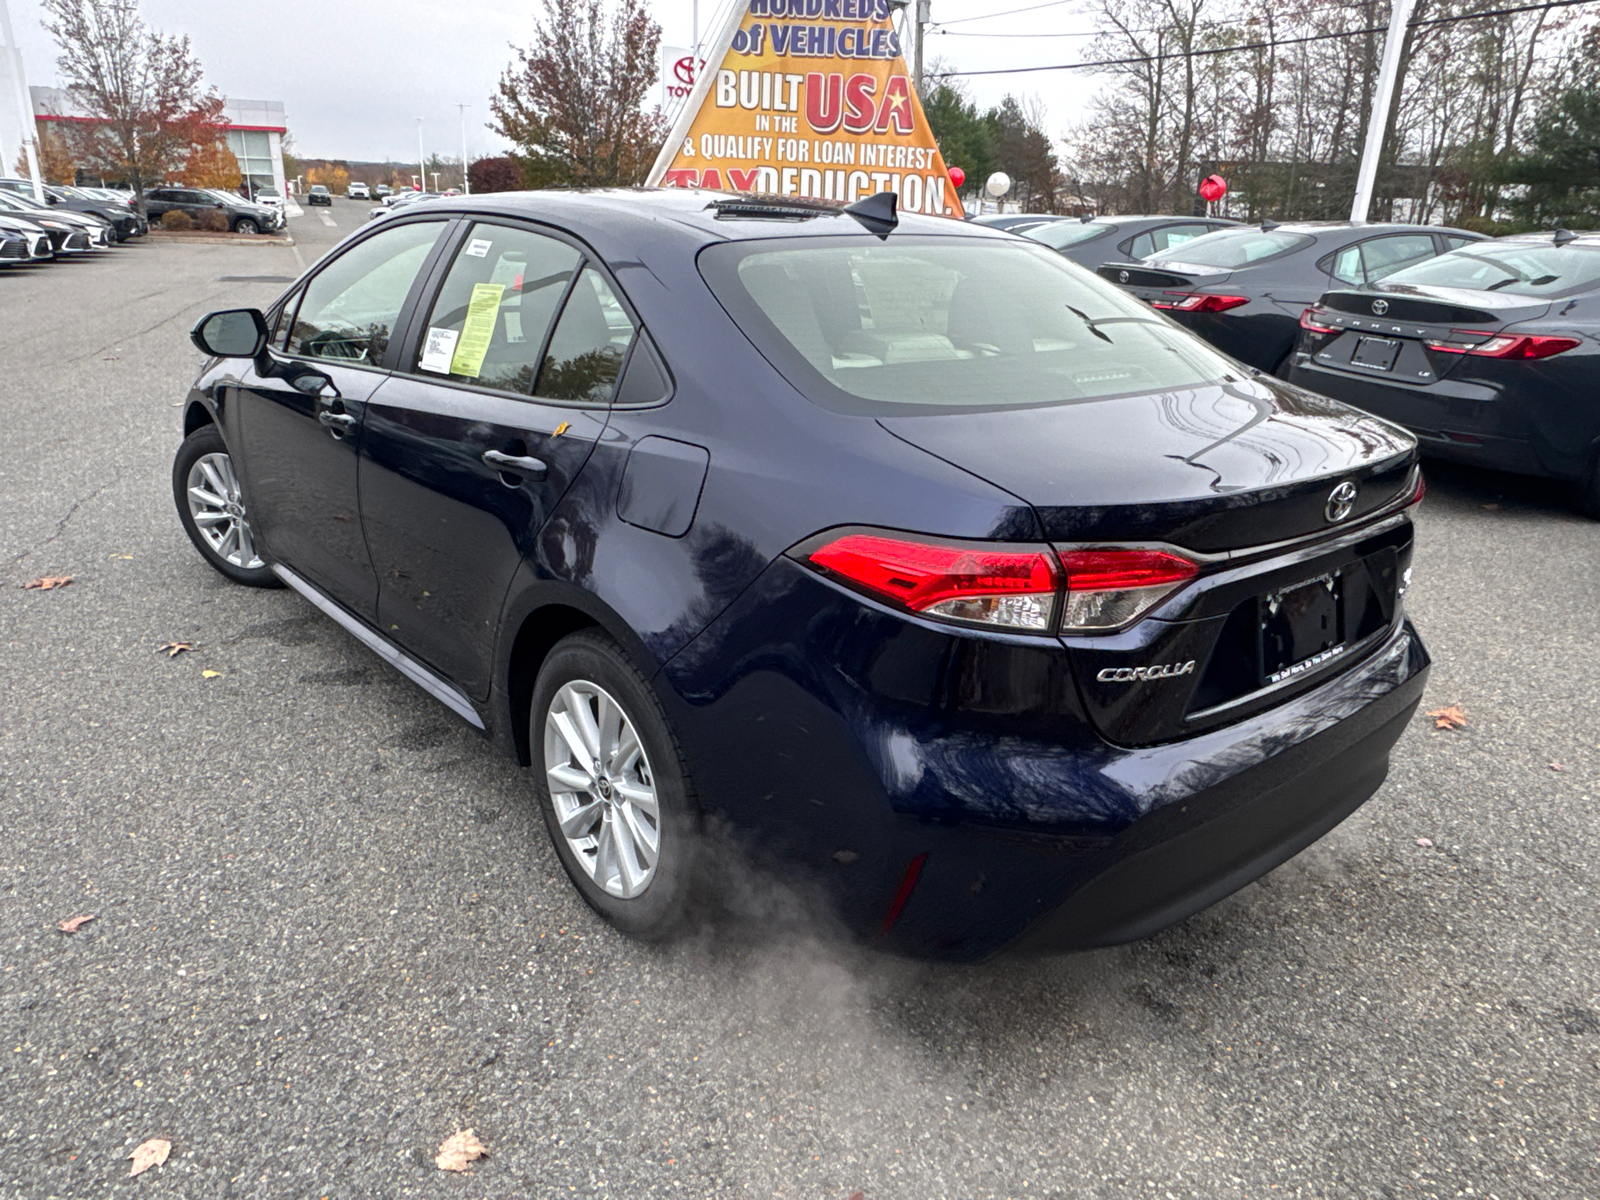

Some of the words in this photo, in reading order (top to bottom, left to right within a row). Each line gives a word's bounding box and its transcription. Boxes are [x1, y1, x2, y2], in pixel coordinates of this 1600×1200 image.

[750, 0, 889, 22] HUNDREDS
[732, 23, 766, 55] of
[770, 24, 903, 60] VEHICLES
[667, 85, 693, 97] TOY
[716, 69, 804, 113] BUILT
[805, 72, 916, 134] USA
[755, 114, 770, 132] IN
[773, 115, 798, 133] THE
[682, 136, 697, 157] &
[701, 133, 773, 160] QUALIFY
[777, 138, 809, 162] FOR
[814, 140, 855, 165] LOAN
[859, 143, 936, 170] INTEREST
[665, 168, 760, 190] TAX
[1336, 318, 1425, 334] CAMRY
[1096, 660, 1196, 682] COROLLA
